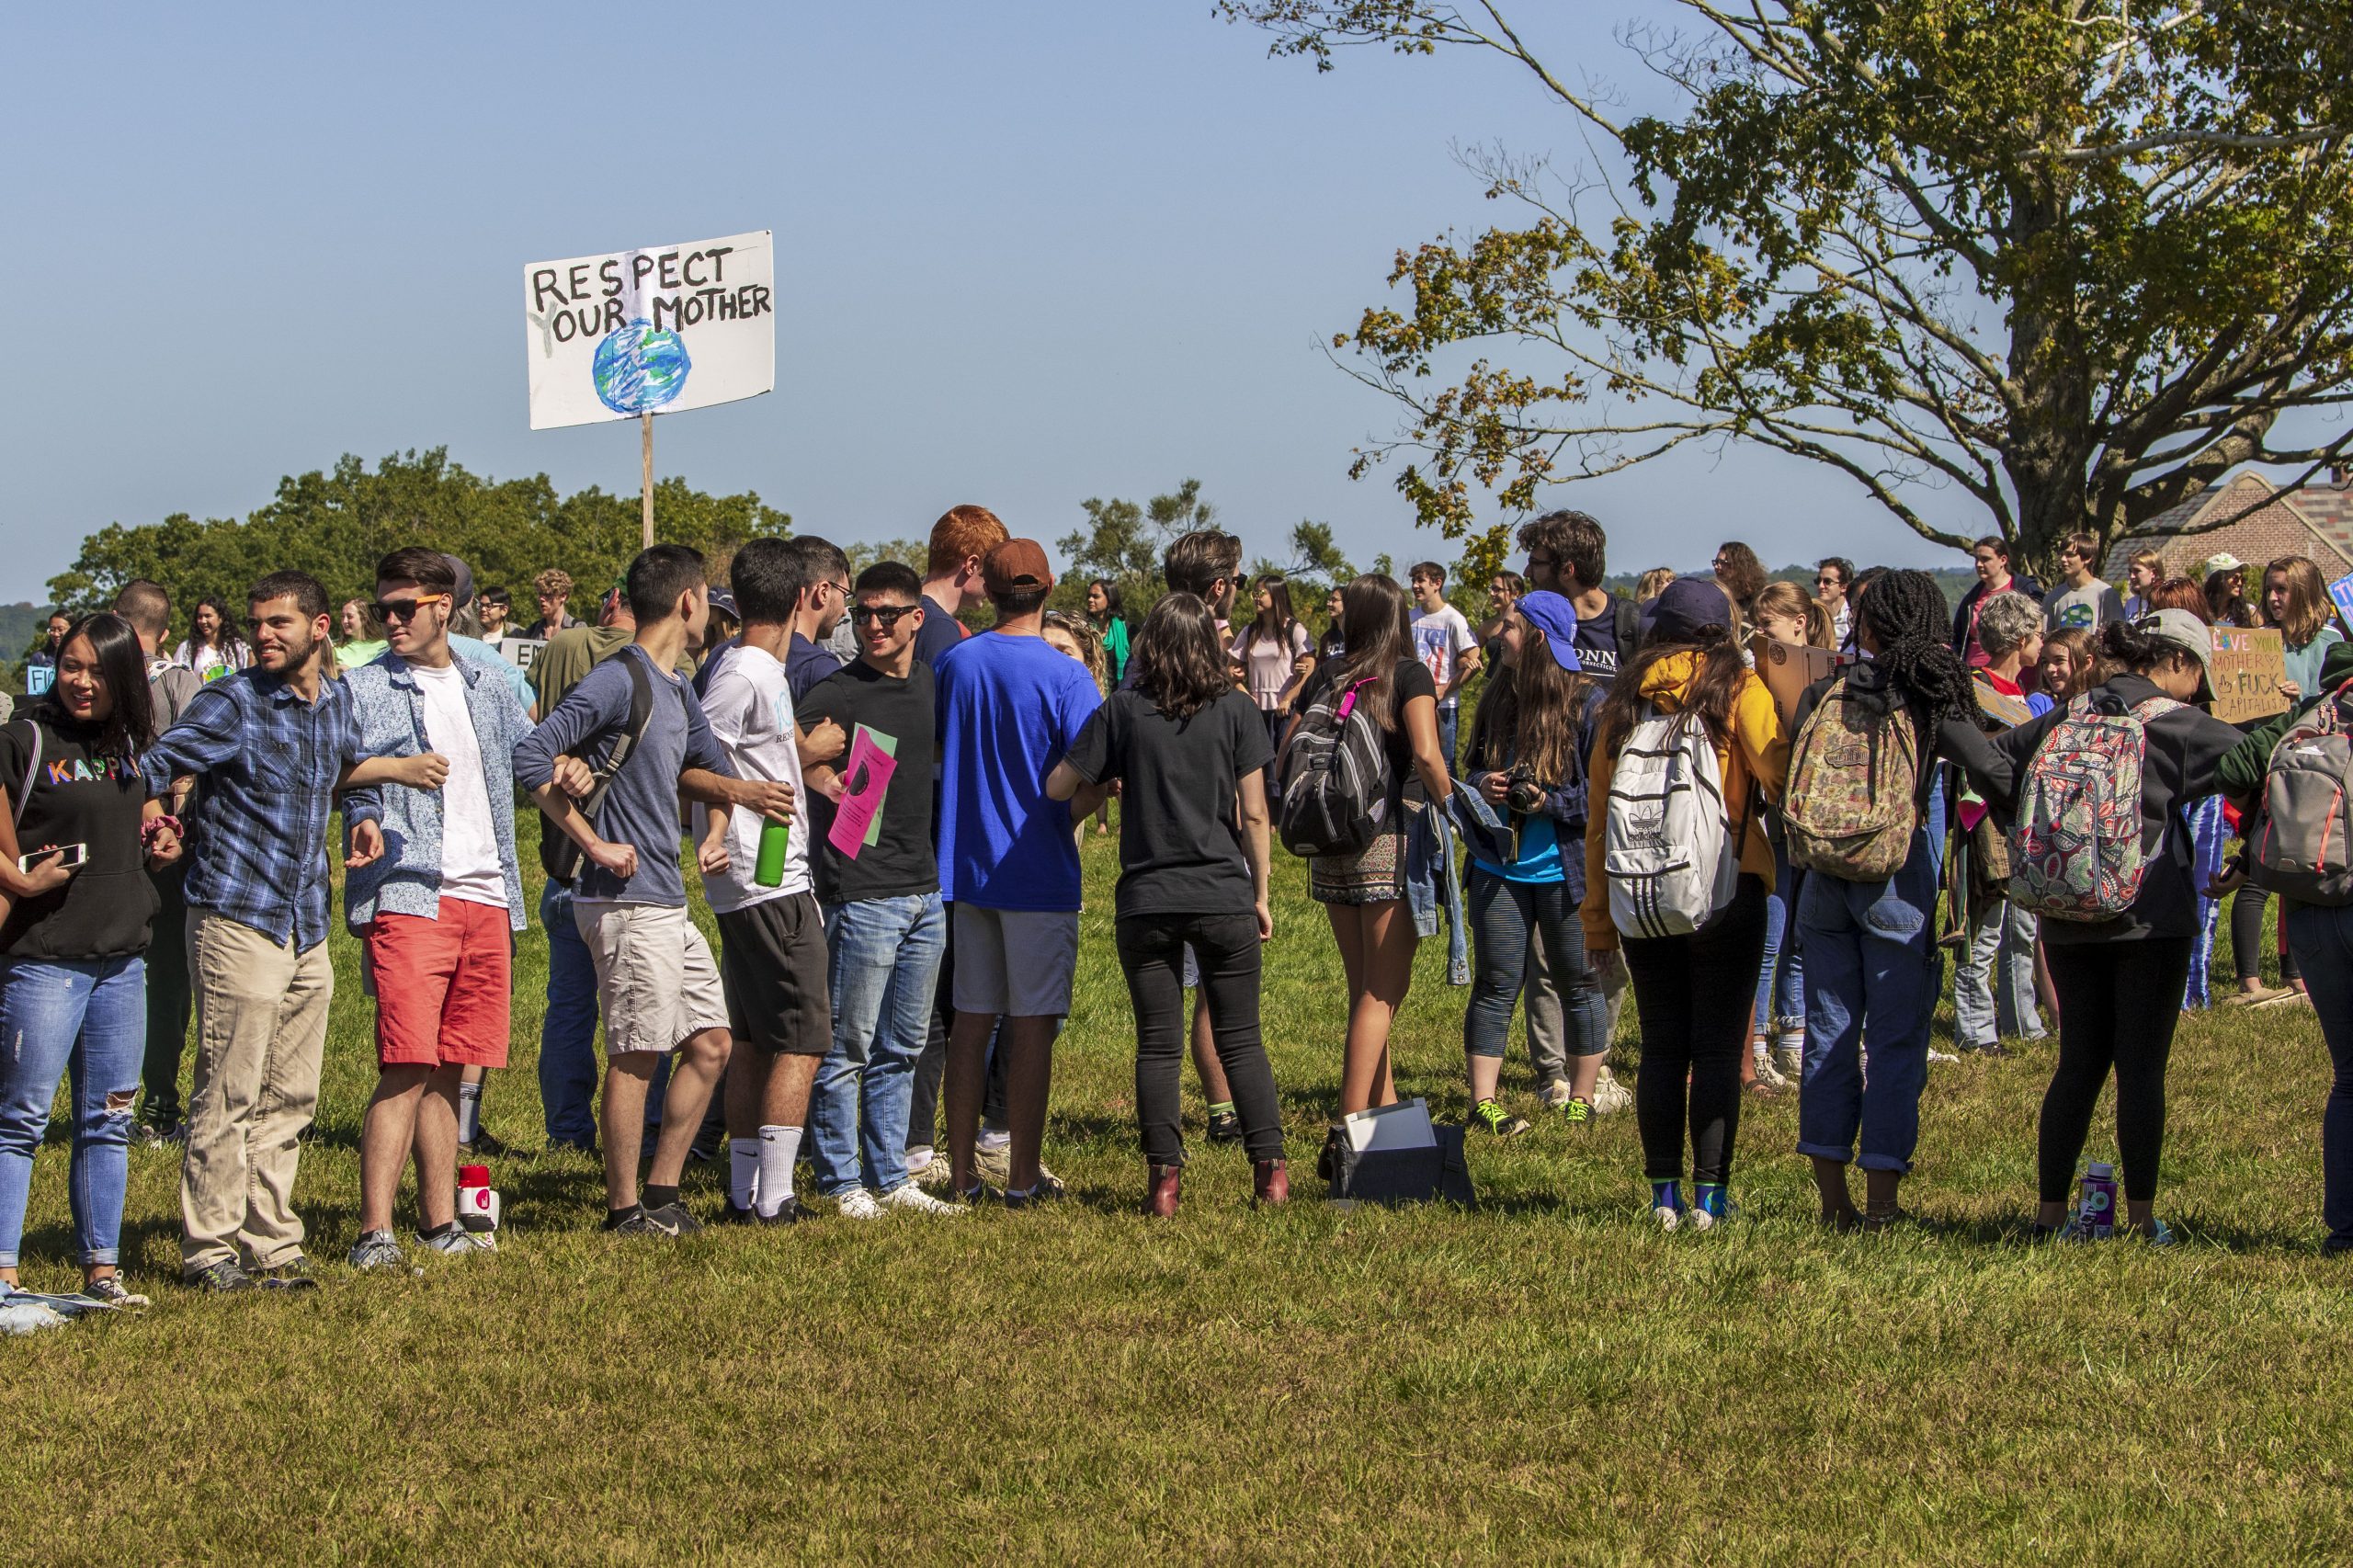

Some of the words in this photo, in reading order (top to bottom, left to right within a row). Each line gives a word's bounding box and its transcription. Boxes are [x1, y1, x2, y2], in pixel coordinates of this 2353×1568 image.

[532, 247, 733, 312] RESPECT
[529, 298, 627, 358] YOUR
[653, 284, 772, 333] MOTHER
[2212, 634, 2251, 652] LOVE
[2255, 636, 2280, 652] YOUR
[2212, 653, 2264, 672] MOTHER
[2237, 673, 2280, 696] FUCK
[2218, 698, 2288, 718] CAPITALISM
[48, 757, 142, 785] KAPPA
